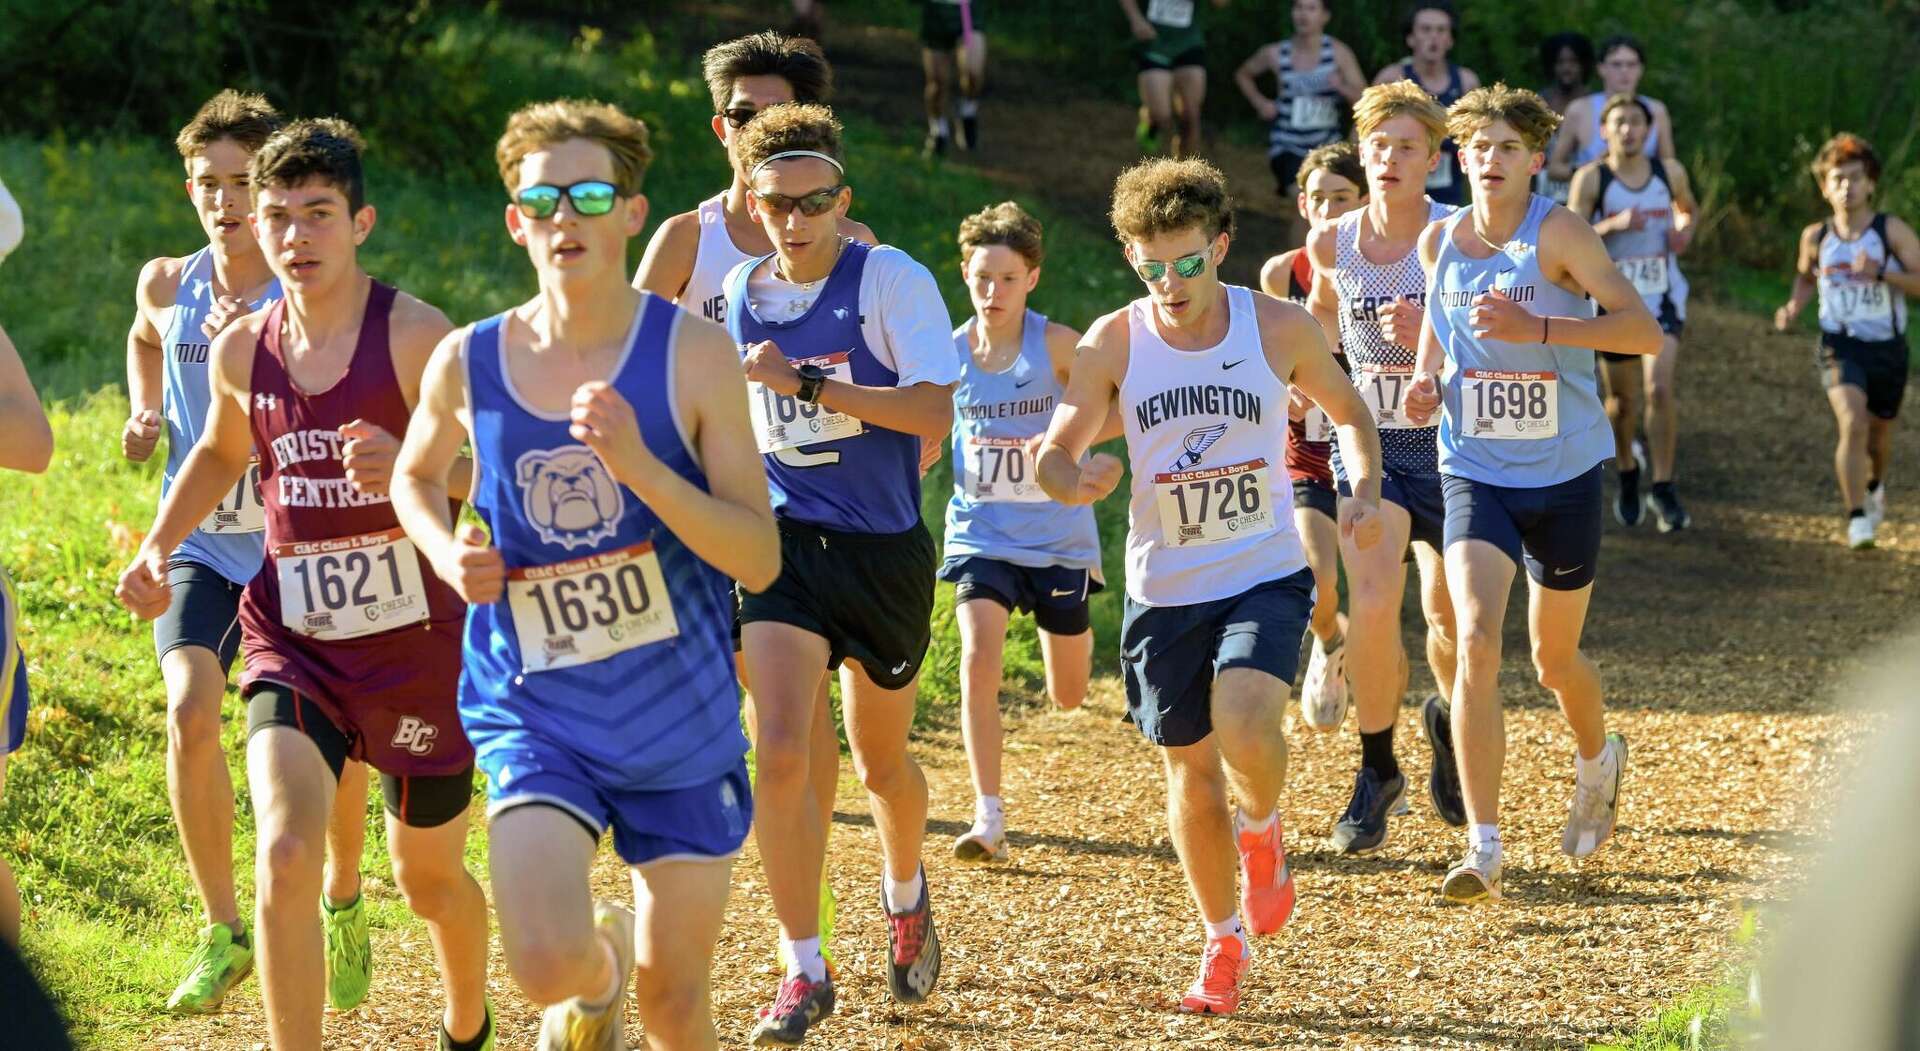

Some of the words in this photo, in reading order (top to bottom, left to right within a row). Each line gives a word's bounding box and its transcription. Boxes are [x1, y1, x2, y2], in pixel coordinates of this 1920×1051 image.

[703, 294, 728, 323] NE
[1475, 371, 1493, 379] CIAC
[1494, 372, 1514, 380] Class
[1521, 373, 1541, 381] Boys
[1136, 385, 1261, 433] NEWINGTON
[1472, 380, 1547, 420] 1698
[1170, 472, 1194, 482] CIAC
[1196, 470, 1220, 479] Class
[1220, 467, 1227, 476] L
[1228, 464, 1249, 474] Boys
[1170, 472, 1260, 525] 1726
[1240, 513, 1265, 524] CHESLA
[294, 544, 321, 555] CIAC
[322, 541, 351, 552] Class
[352, 538, 360, 548] L
[361, 535, 389, 546] Boys
[293, 545, 403, 613] 1621
[526, 563, 650, 635] 1630
[391, 715, 438, 756] BC
